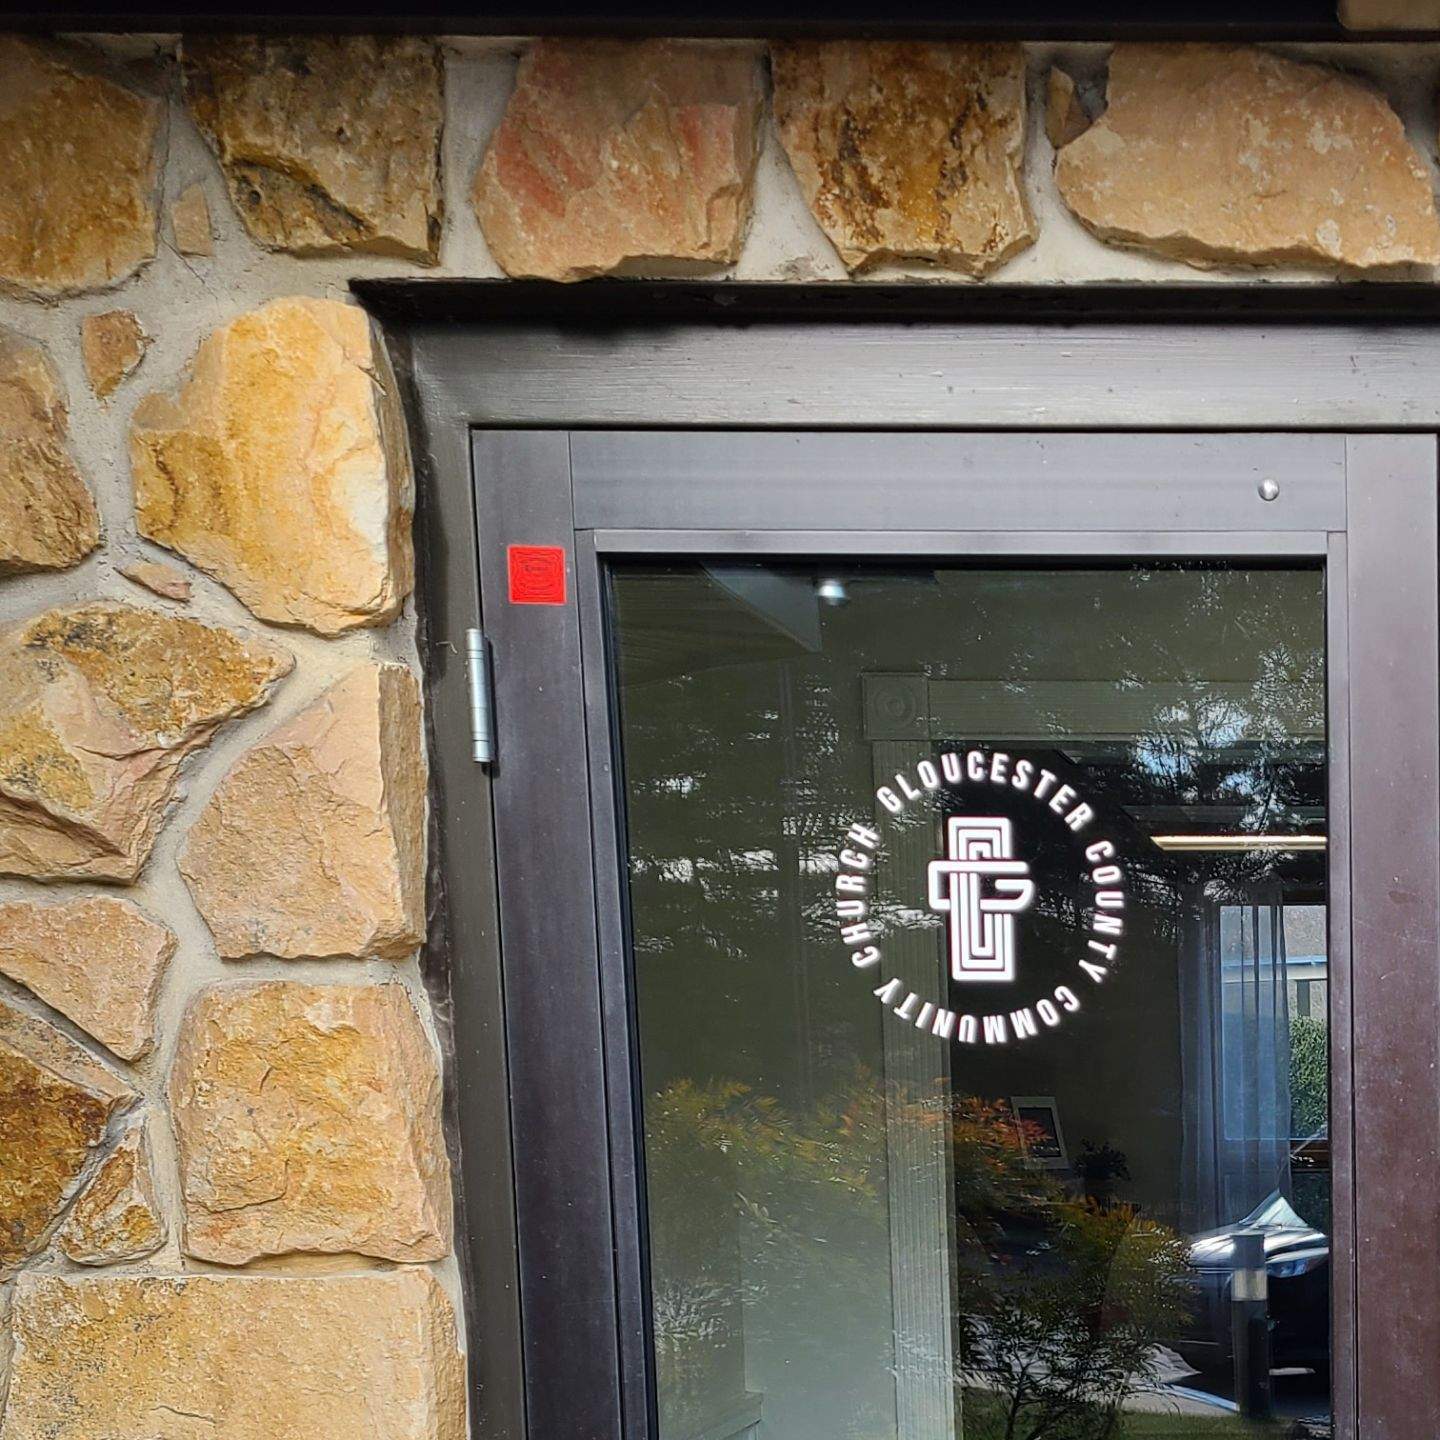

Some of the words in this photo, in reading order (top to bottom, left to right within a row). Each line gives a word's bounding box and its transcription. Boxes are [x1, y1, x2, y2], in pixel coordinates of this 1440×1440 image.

[876, 751, 1093, 831] GLOUCESTER
[836, 822, 881, 968] CHURCH
[1078, 840, 1124, 983] COUNTY
[873, 978, 1080, 1043] COMMUNITY
